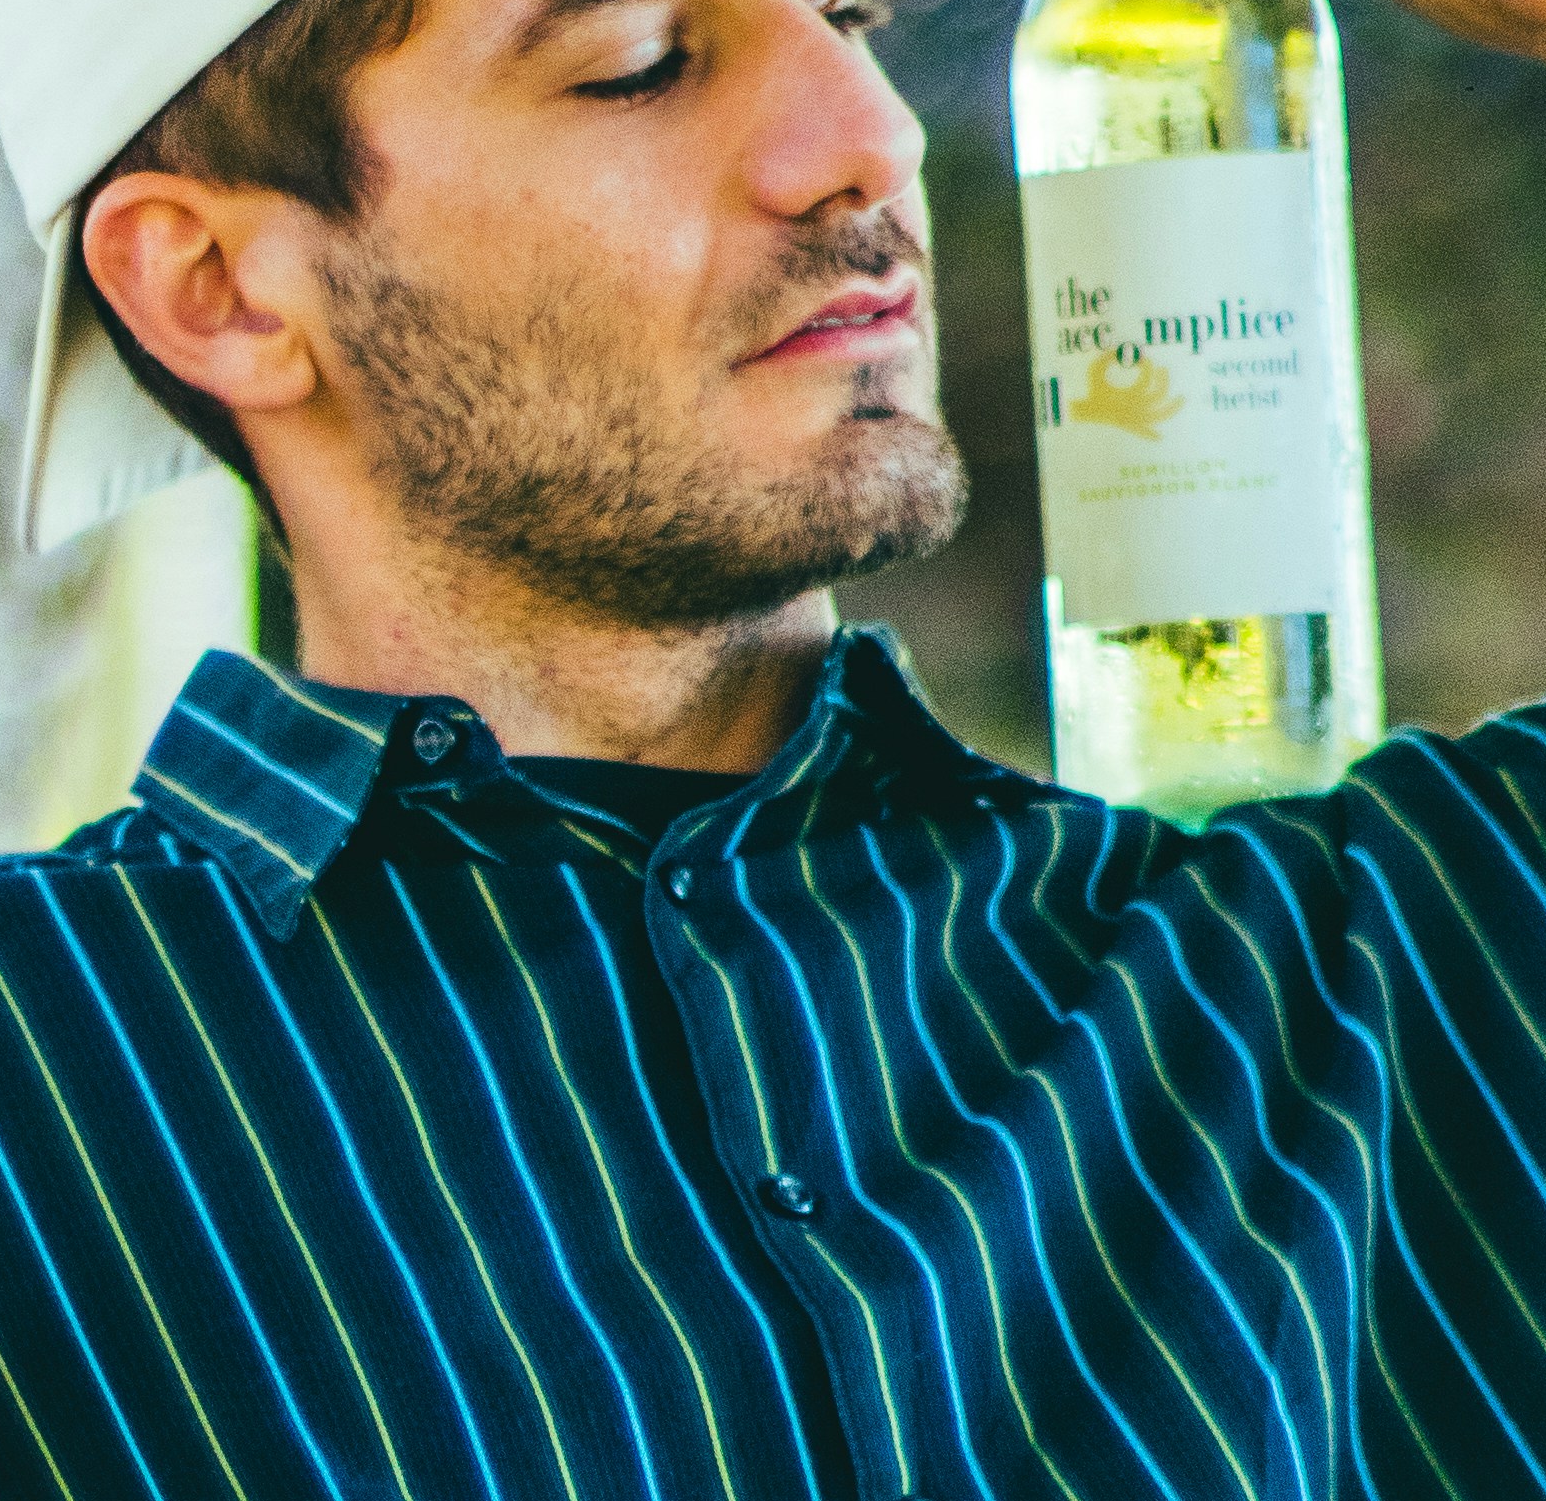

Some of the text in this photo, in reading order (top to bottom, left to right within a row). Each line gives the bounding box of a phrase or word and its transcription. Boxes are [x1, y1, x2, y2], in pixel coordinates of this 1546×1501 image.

[1055, 276, 1112, 318] the
[1056, 298, 1295, 368] accomplice
[1208, 349, 1300, 377] second
[1212, 385, 1281, 412] heist
